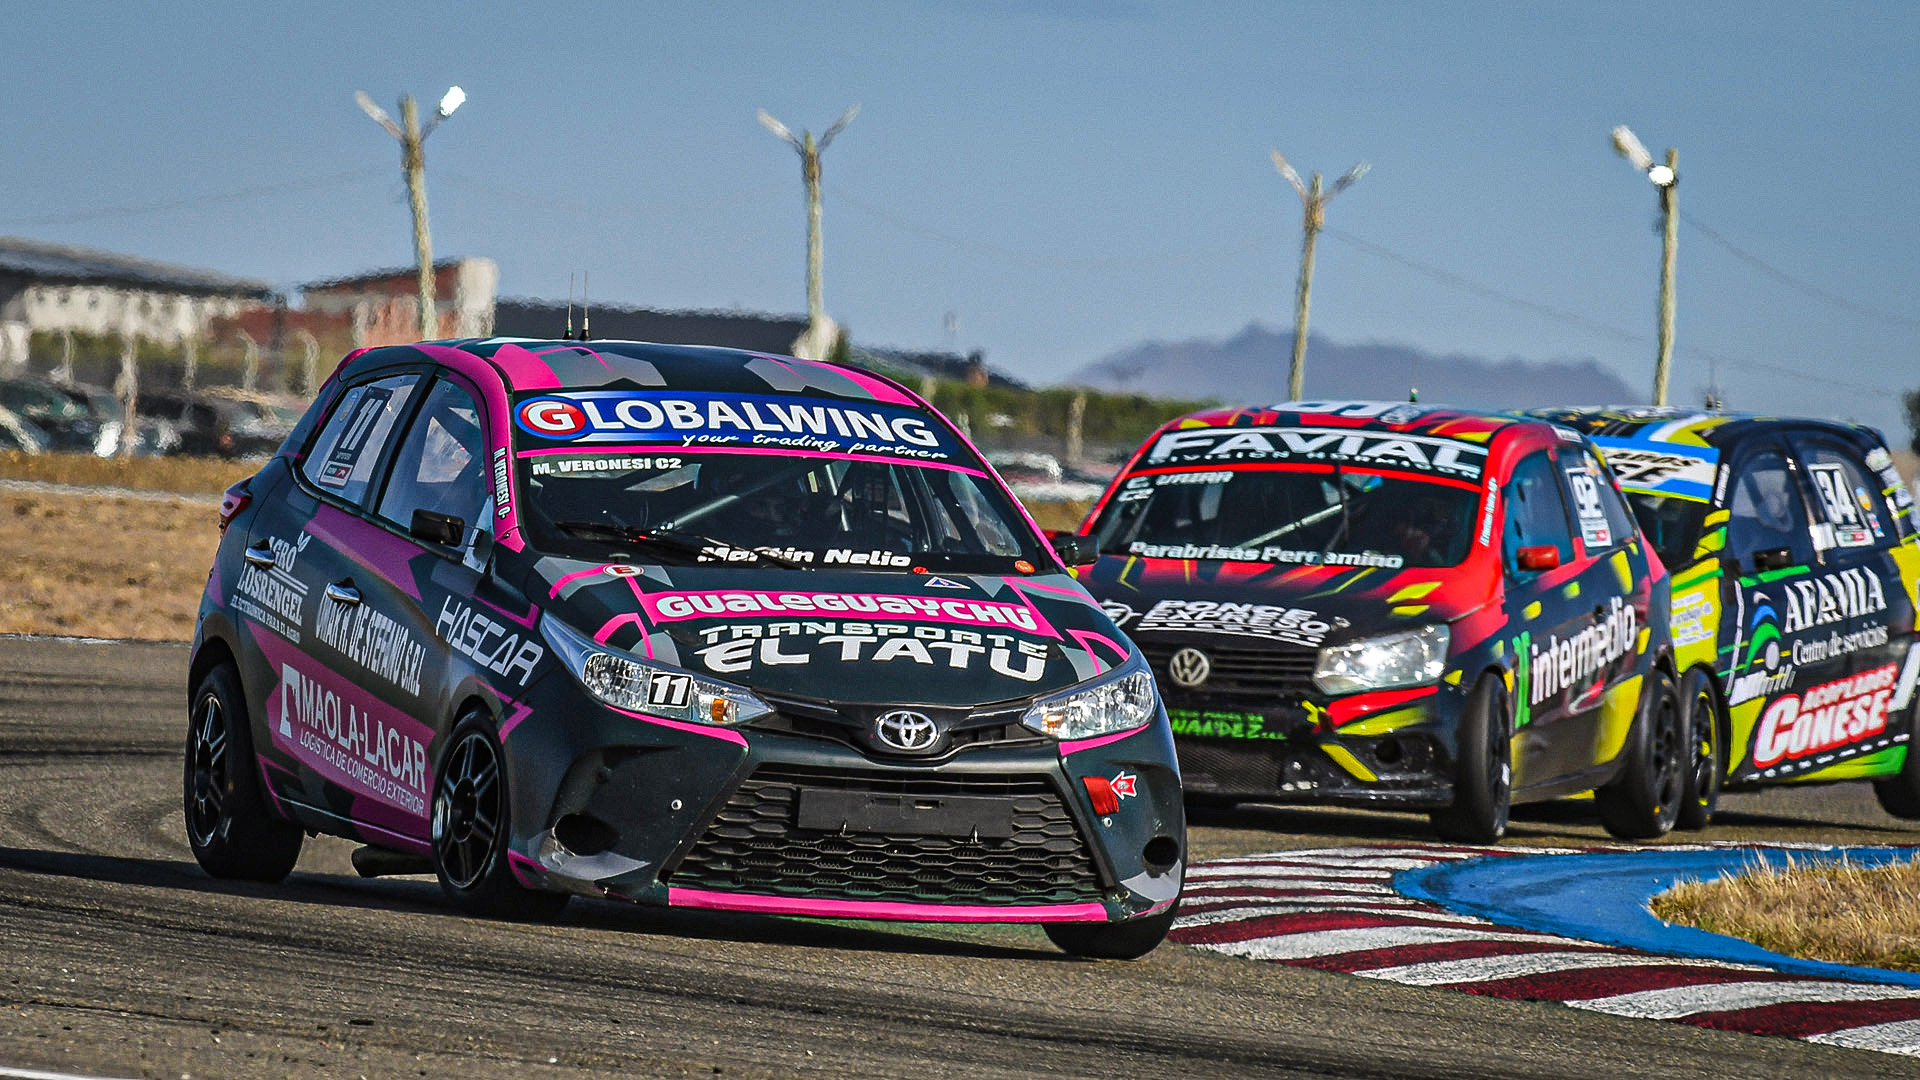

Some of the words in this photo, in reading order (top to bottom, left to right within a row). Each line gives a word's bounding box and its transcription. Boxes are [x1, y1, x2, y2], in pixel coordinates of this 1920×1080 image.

[340, 398, 384, 451] 11
[526, 400, 940, 448] GLOBALWING
[682, 433, 740, 448] your
[752, 433, 840, 452] trading
[847, 443, 949, 459] partner
[494, 458, 510, 507] VERONESI
[532, 463, 555, 475] M.
[558, 458, 652, 473] VERONESI
[655, 458, 682, 470] C2
[1816, 471, 1858, 524] 34
[823, 549, 912, 567] Nelio
[1130, 541, 1260, 561] Parabrisas
[237, 563, 303, 627] LOSRENGEL
[348, 602, 370, 663] DE
[361, 609, 410, 686] STEFANO
[435, 594, 544, 686] HASCAR
[694, 637, 810, 674] EL
[818, 636, 1047, 681] TATU
[1532, 596, 1636, 705] intermedio
[652, 674, 690, 706] 11
[301, 674, 426, 795] MAOLA-LACAR
[1755, 690, 1892, 763] CONESE
[300, 728, 336, 766] LOGISTICA
[335, 751, 347, 772] DE
[347, 758, 387, 794] COMERCIO
[386, 781, 425, 817] EXTERIOR
